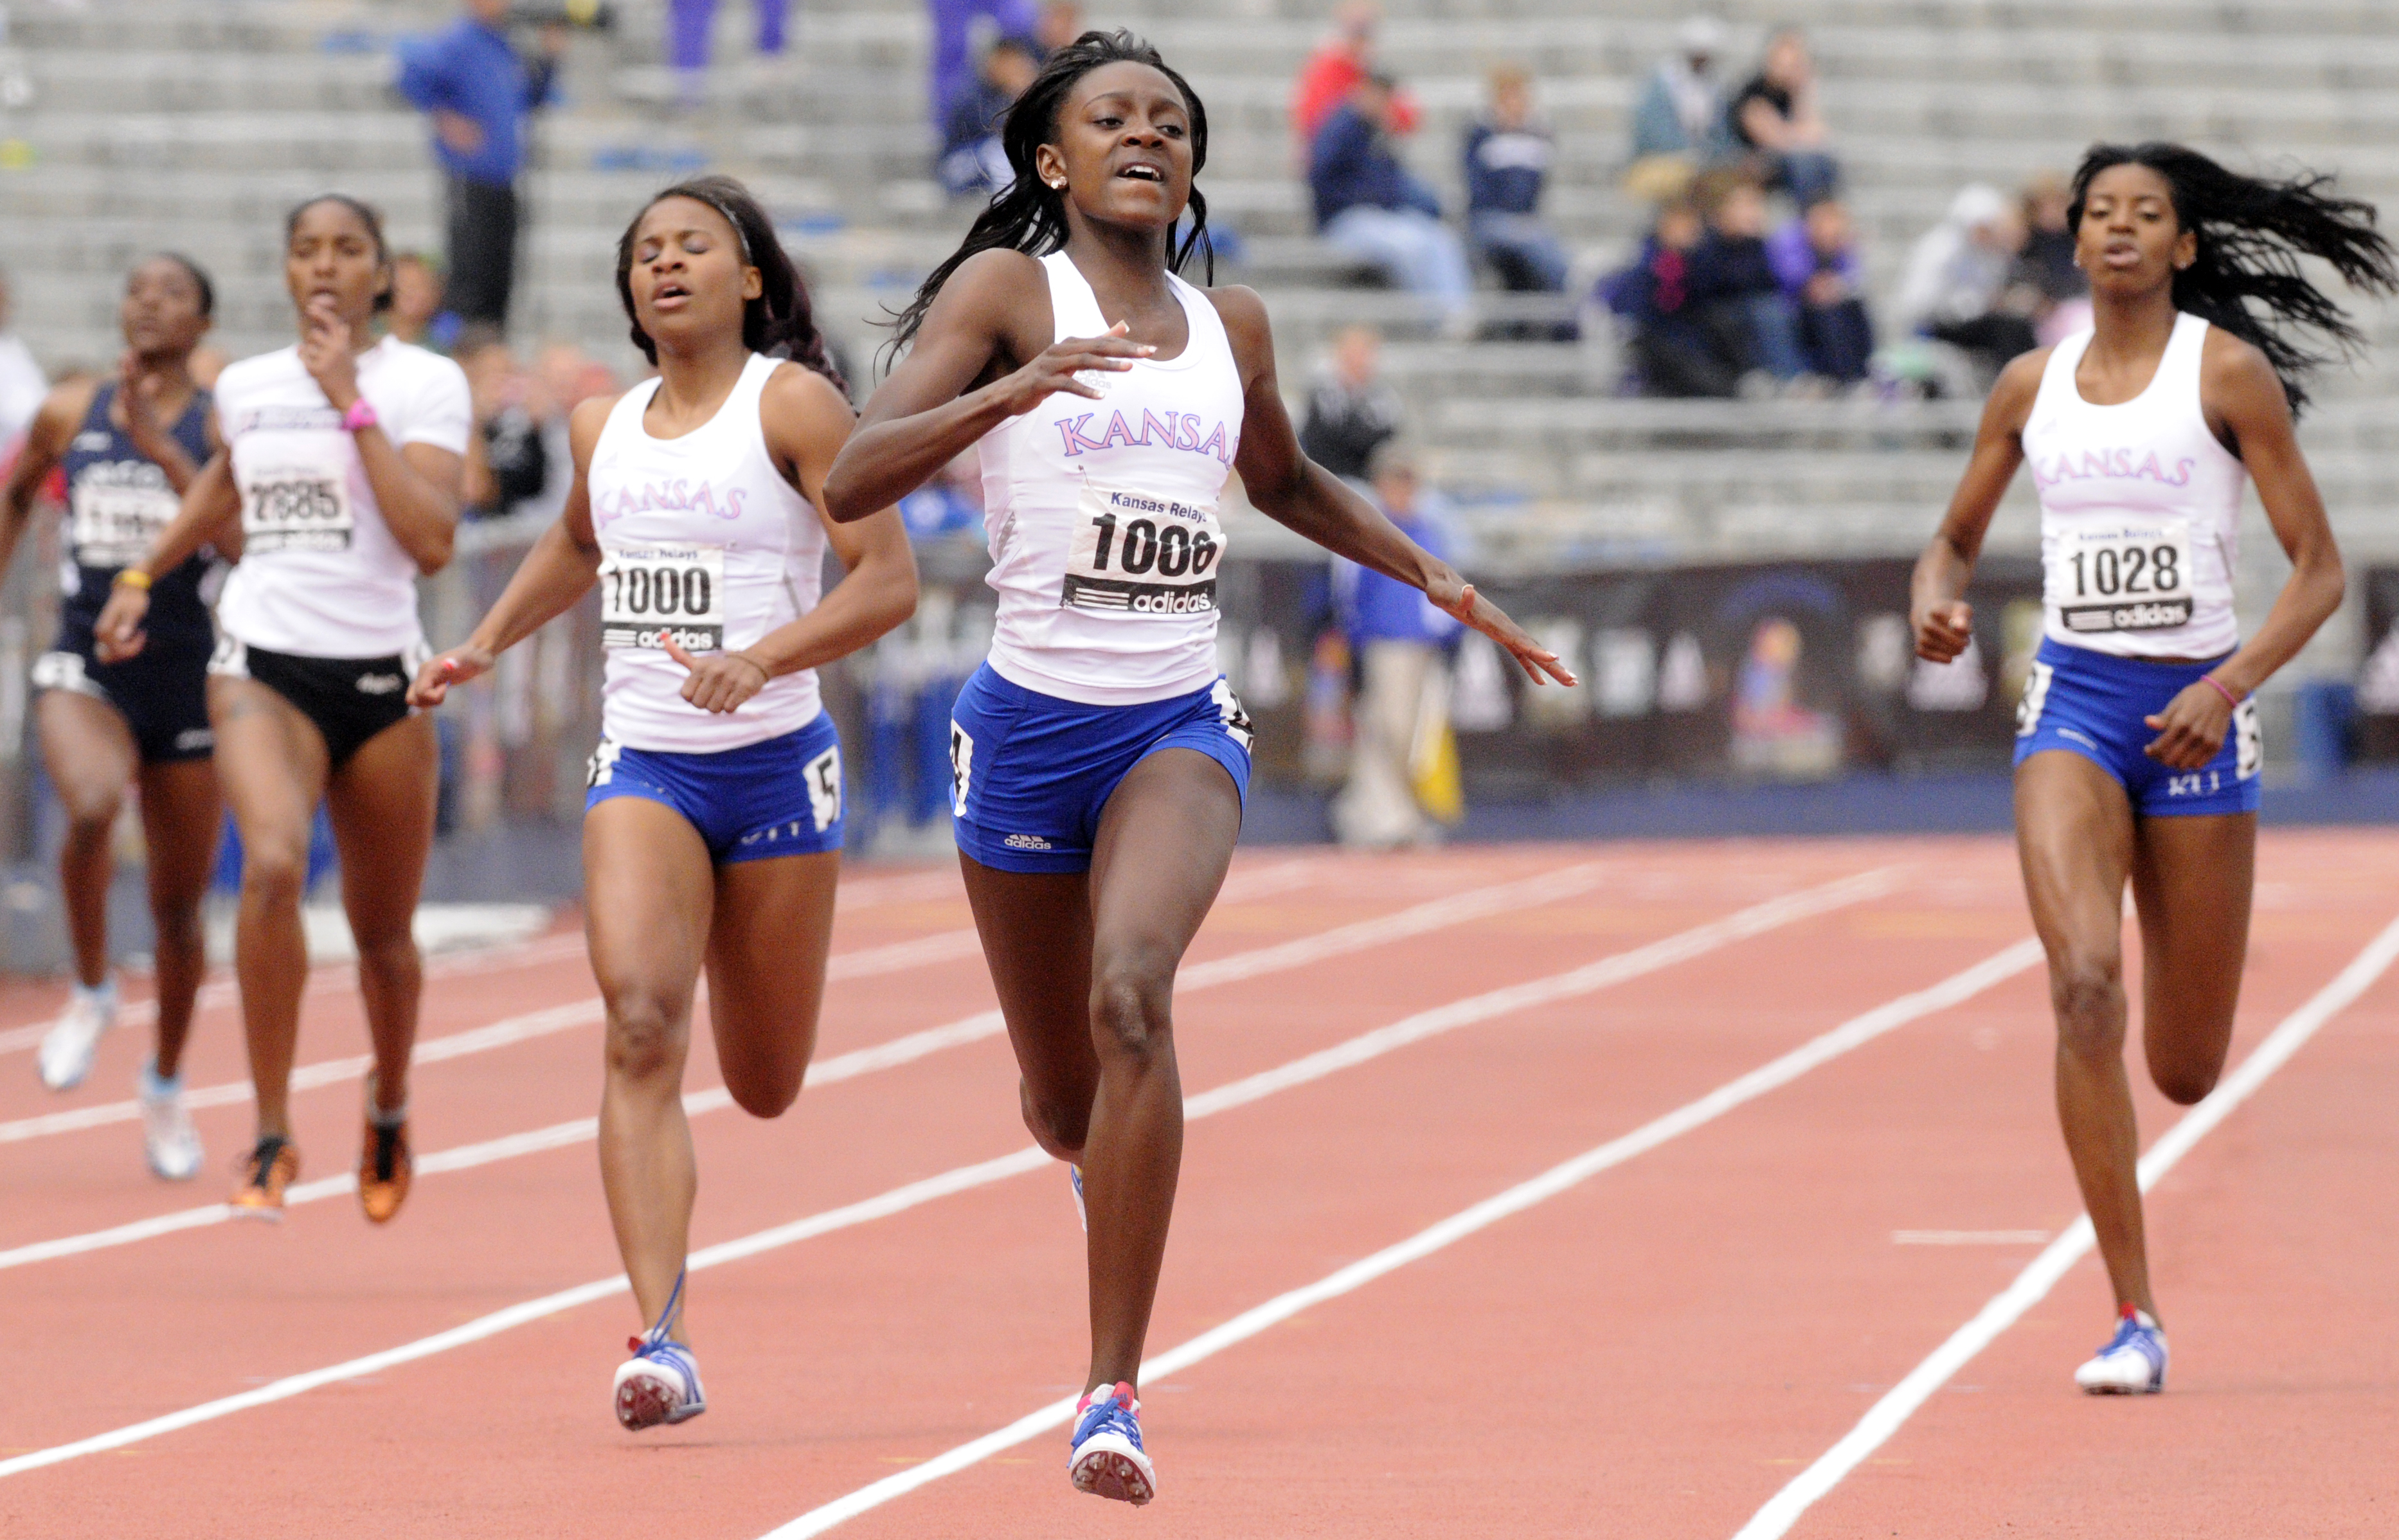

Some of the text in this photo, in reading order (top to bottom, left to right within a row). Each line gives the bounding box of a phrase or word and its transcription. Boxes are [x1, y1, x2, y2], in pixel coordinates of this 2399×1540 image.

[595, 479, 746, 530] KANSAS
[1111, 492, 1207, 524] Kansas Relays
[609, 566, 711, 615] 1000
[2070, 546, 2180, 596] 1028
[1133, 591, 1212, 614] adidas
[817, 755, 836, 826] 5
[1004, 837, 1052, 850] adidas
